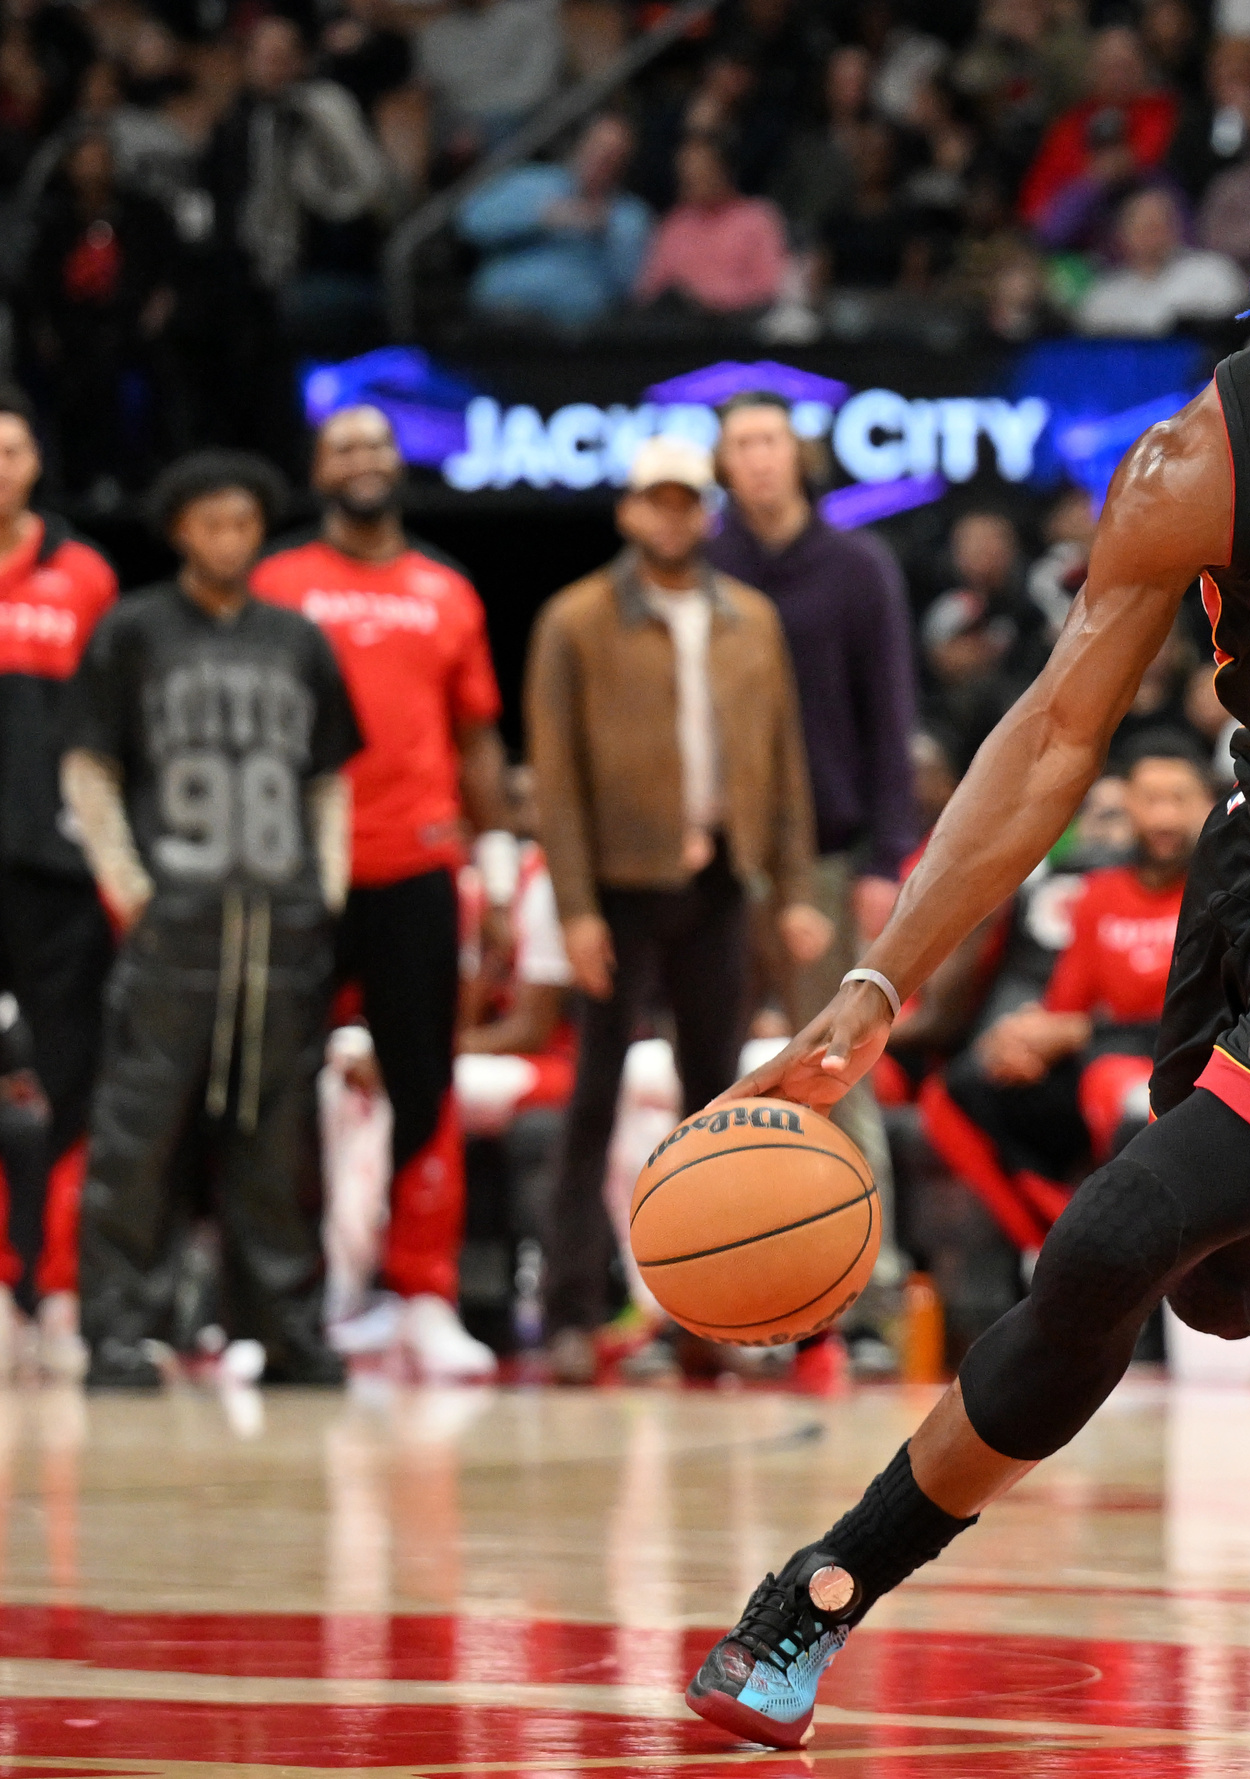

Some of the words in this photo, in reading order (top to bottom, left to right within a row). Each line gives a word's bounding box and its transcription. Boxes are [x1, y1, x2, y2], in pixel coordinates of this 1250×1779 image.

[443, 396, 834, 491] JACK
[832, 387, 1048, 483] CITY
[647, 1106, 805, 1168] Wilson
